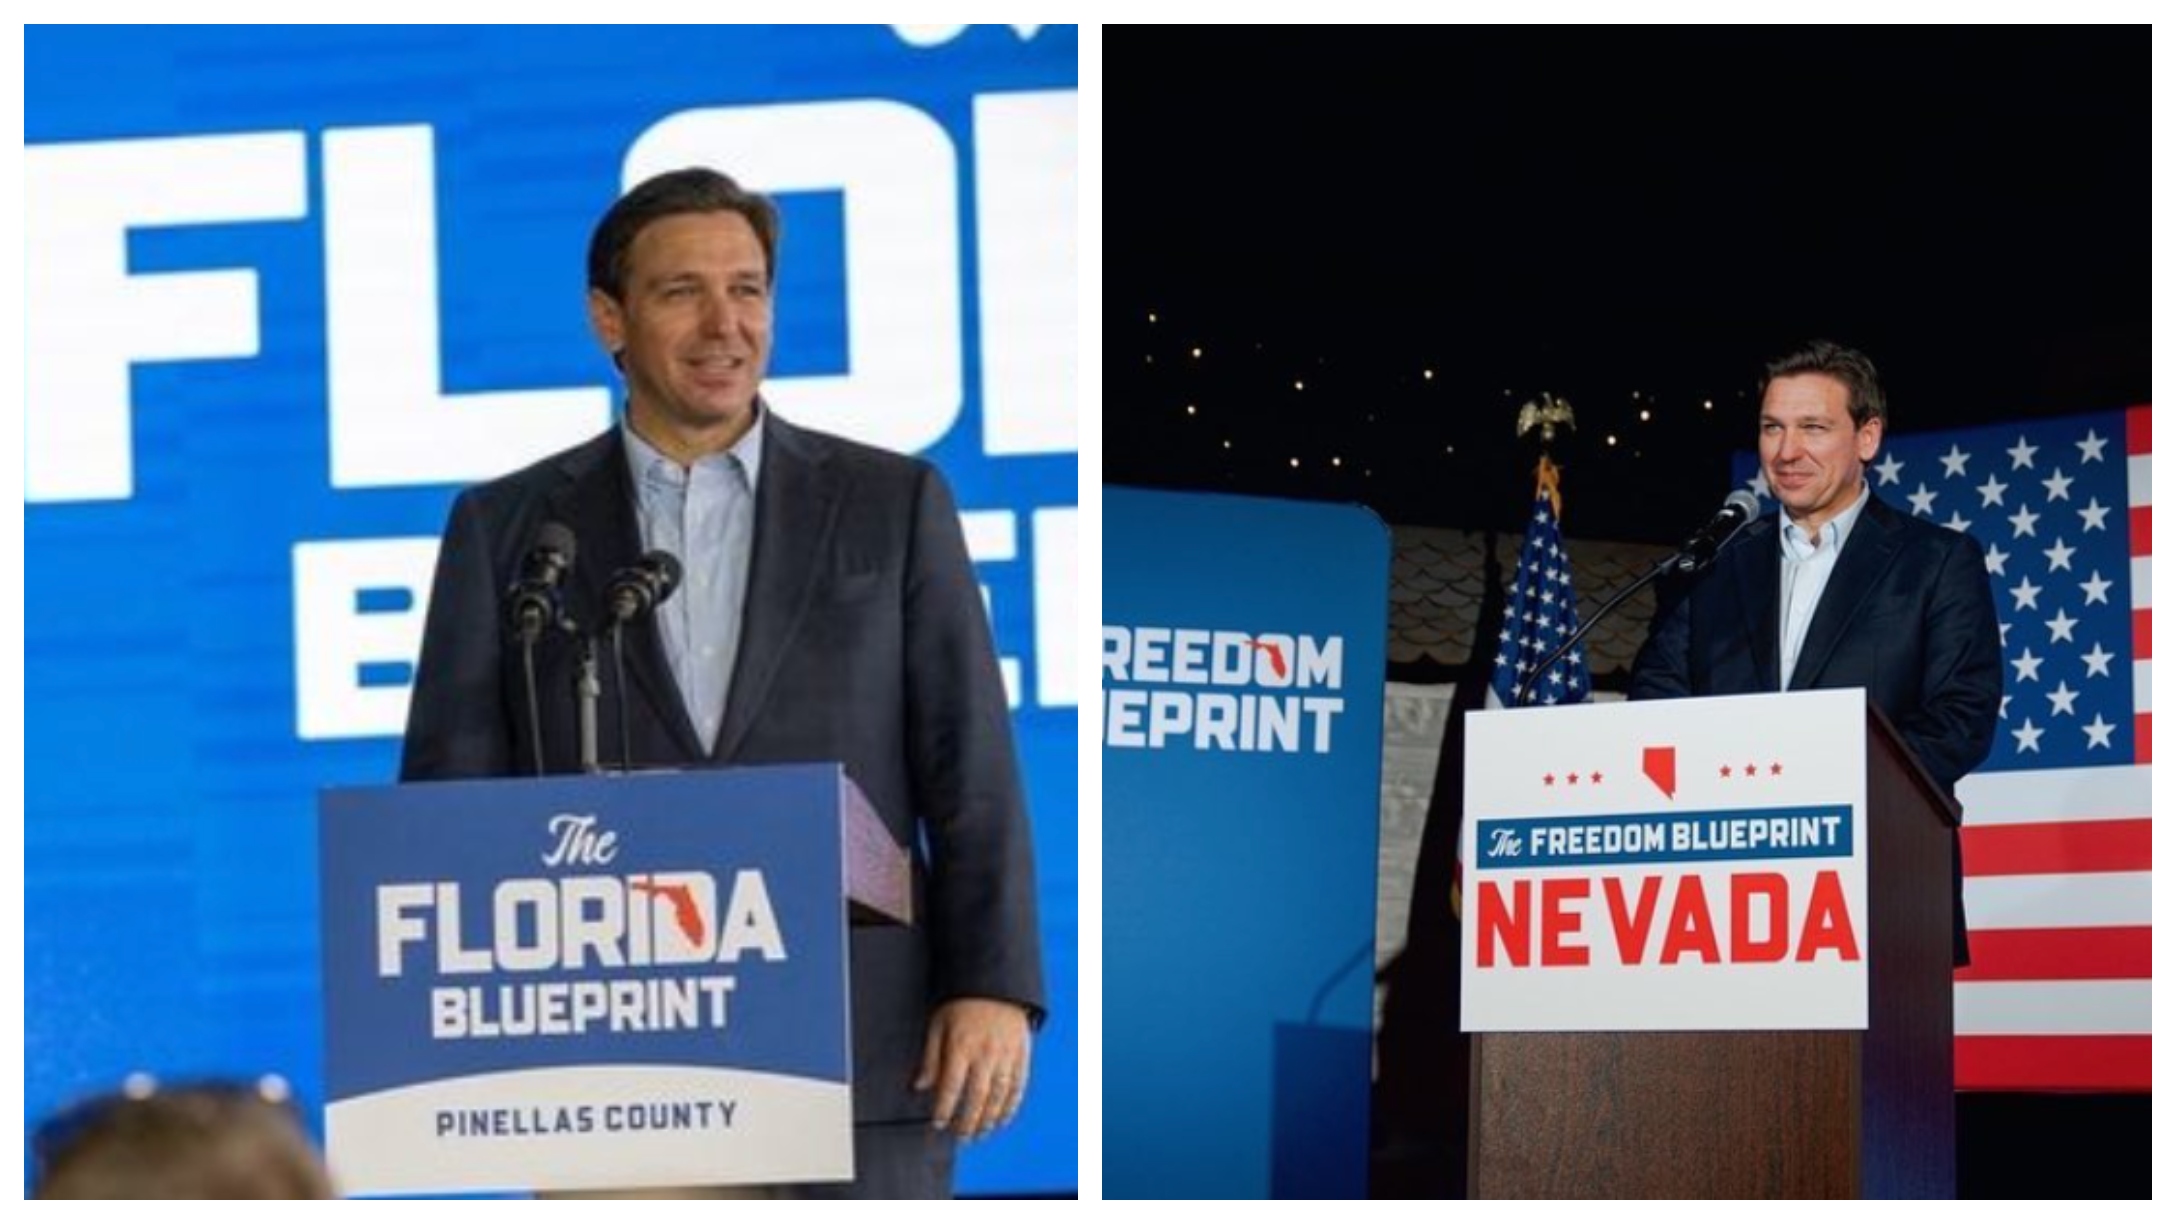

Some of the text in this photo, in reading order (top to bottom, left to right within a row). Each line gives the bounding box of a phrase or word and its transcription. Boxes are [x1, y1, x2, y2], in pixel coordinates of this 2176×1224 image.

[542, 814, 619, 867] The
[1487, 815, 1841, 858] The FREEDOM BLUEPRINT
[376, 869, 788, 977] FLORIDA
[1476, 870, 1861, 968] NEVADA
[431, 976, 737, 1039] BLUEPRINT
[436, 1101, 738, 1138] PINELLAS COUNTY
